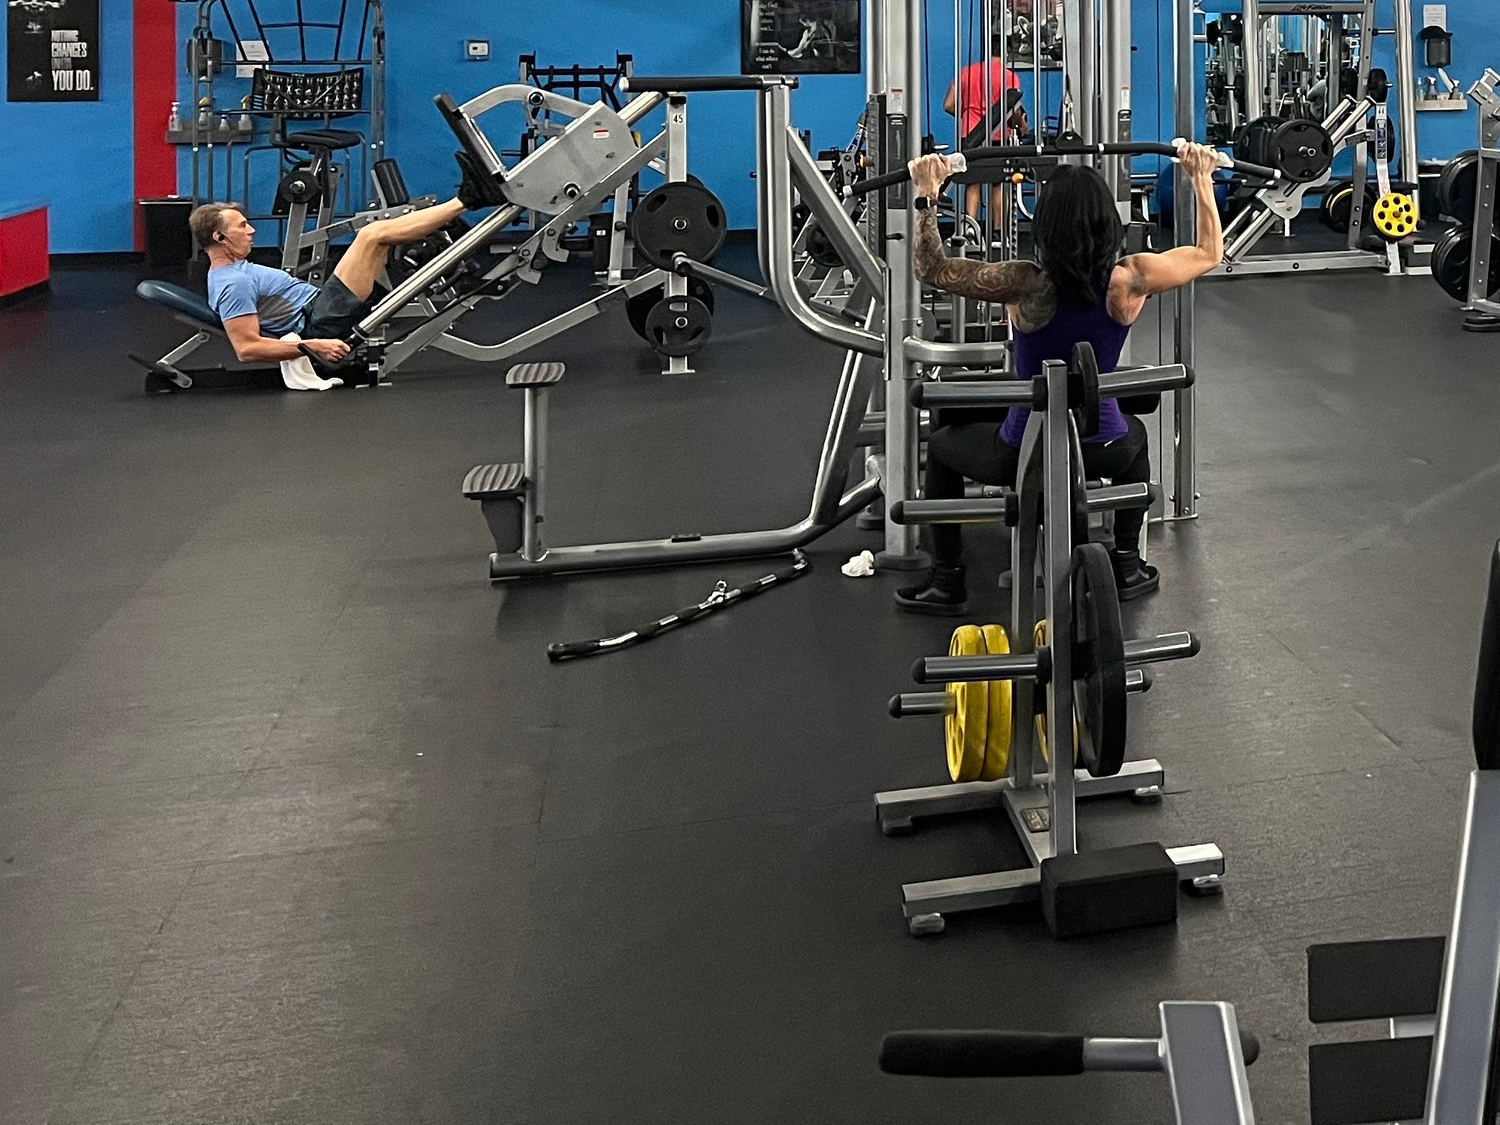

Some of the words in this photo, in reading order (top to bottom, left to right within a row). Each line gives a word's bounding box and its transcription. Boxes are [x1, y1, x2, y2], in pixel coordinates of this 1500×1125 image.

[51, 42, 87, 58] CHANGES
[52, 70, 73, 91] YOU
[76, 70, 94, 91] DO.
[673, 114, 683, 124] 45
